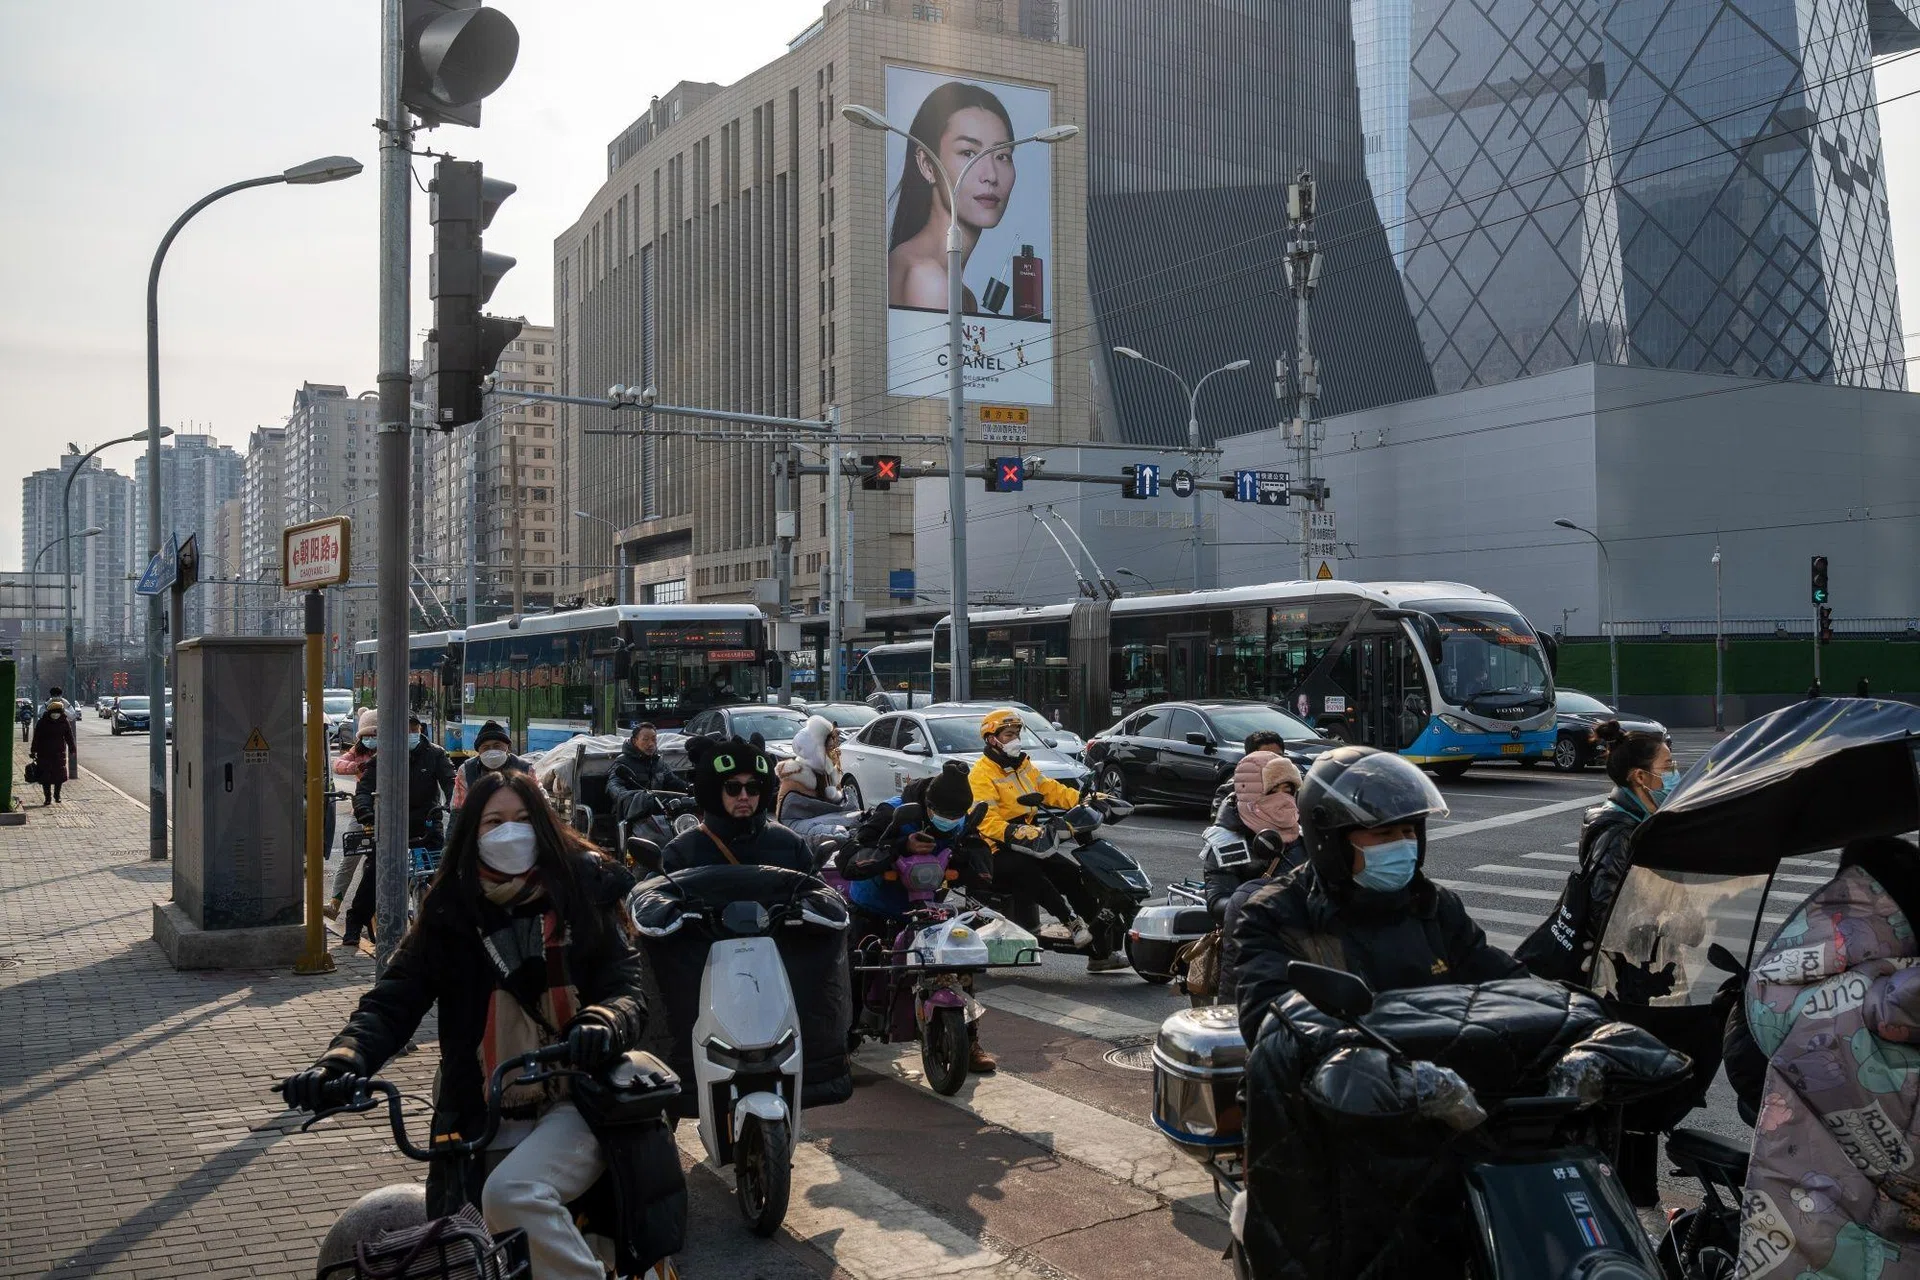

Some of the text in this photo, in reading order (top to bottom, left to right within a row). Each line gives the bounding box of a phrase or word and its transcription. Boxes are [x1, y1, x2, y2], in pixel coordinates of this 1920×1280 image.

[937, 353, 1005, 371] CANEL
[300, 533, 331, 566] 朝阳路
